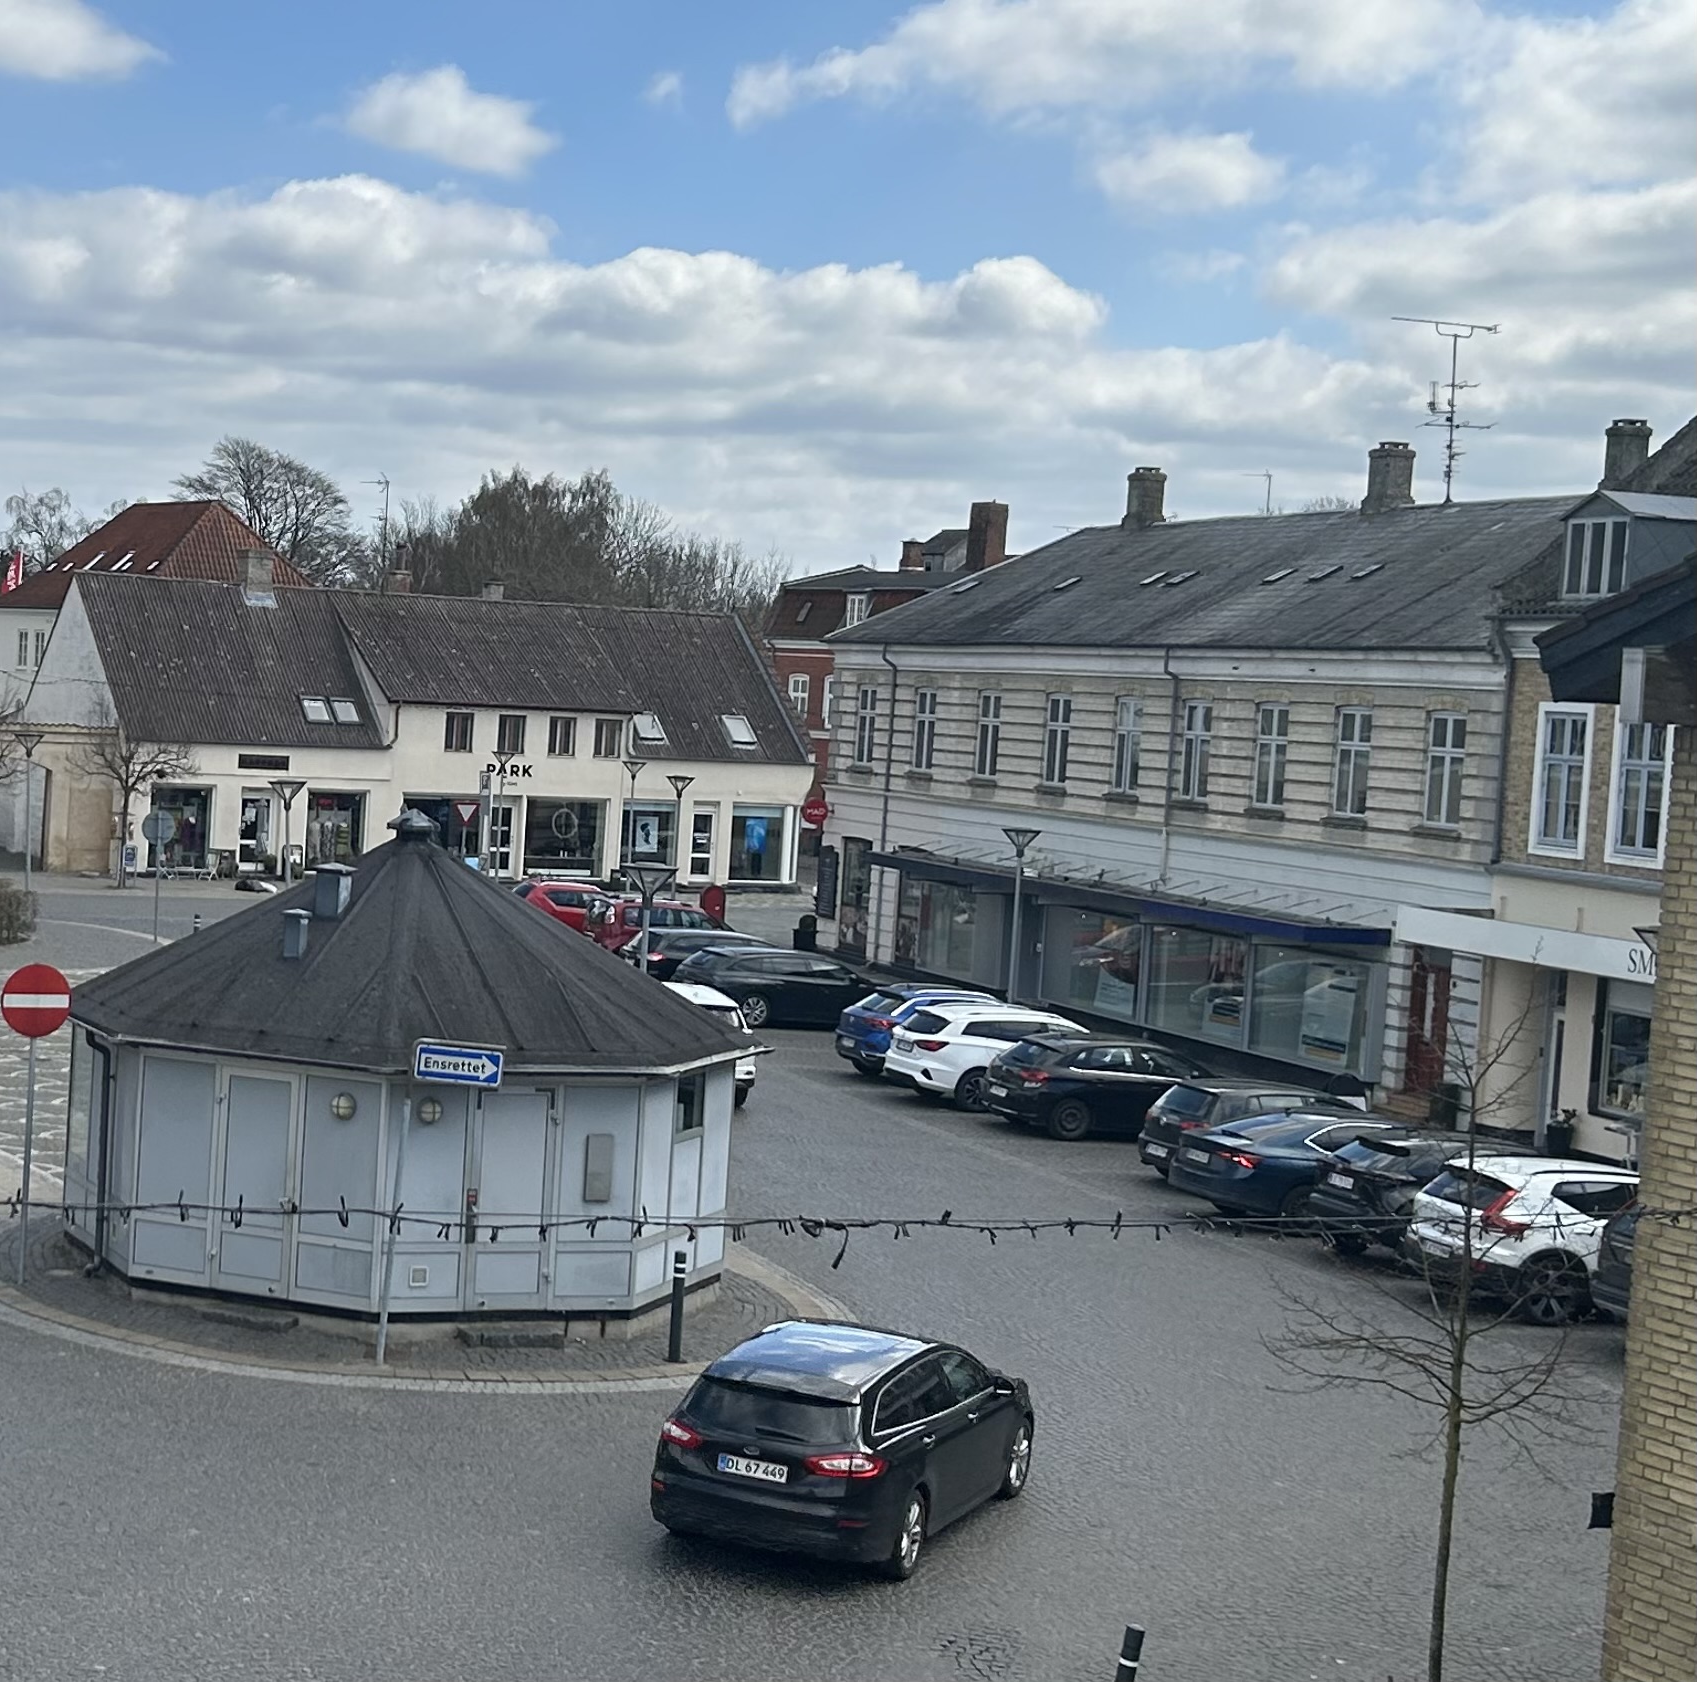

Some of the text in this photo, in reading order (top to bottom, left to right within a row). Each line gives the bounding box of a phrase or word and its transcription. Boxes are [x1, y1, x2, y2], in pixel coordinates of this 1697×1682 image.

[486, 763, 533, 777] PARK
[1627, 948, 1653, 975] SM
[423, 1056, 486, 1074] Ensrettet
[726, 1458, 785, 1479] DL 67 449
